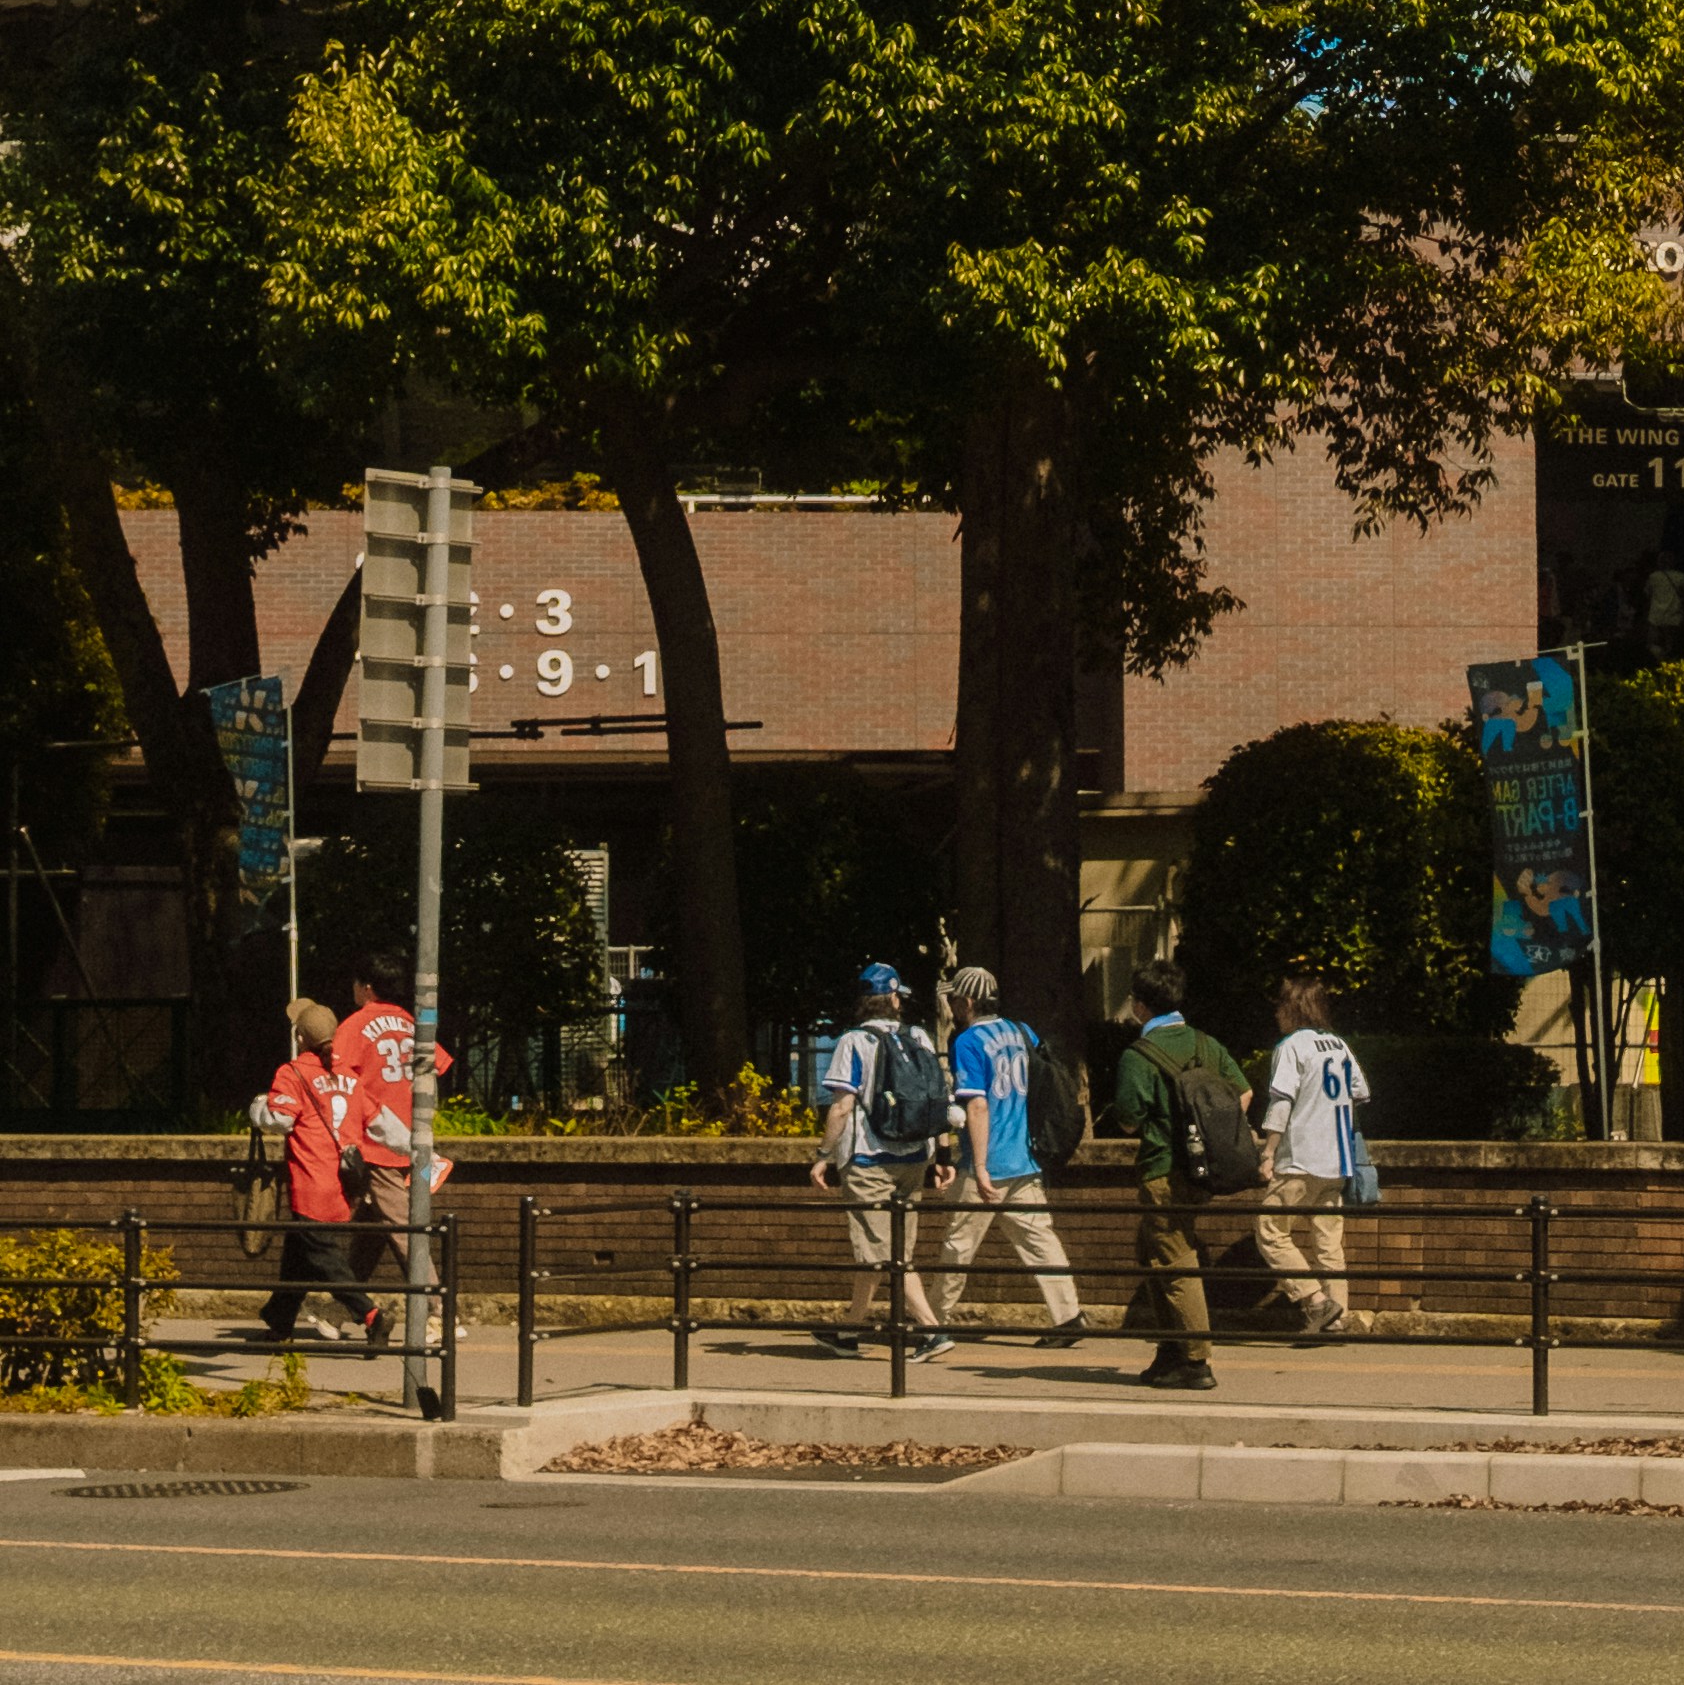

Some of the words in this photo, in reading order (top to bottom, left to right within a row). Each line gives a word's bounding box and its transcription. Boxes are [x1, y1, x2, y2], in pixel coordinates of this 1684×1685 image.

[1566, 428, 1607, 445] THE
[1616, 429, 1679, 446] WING
[1592, 473, 1639, 489] GATE
[991, 1051, 1029, 1099] 80
[1322, 1056, 1353, 1100] 61
